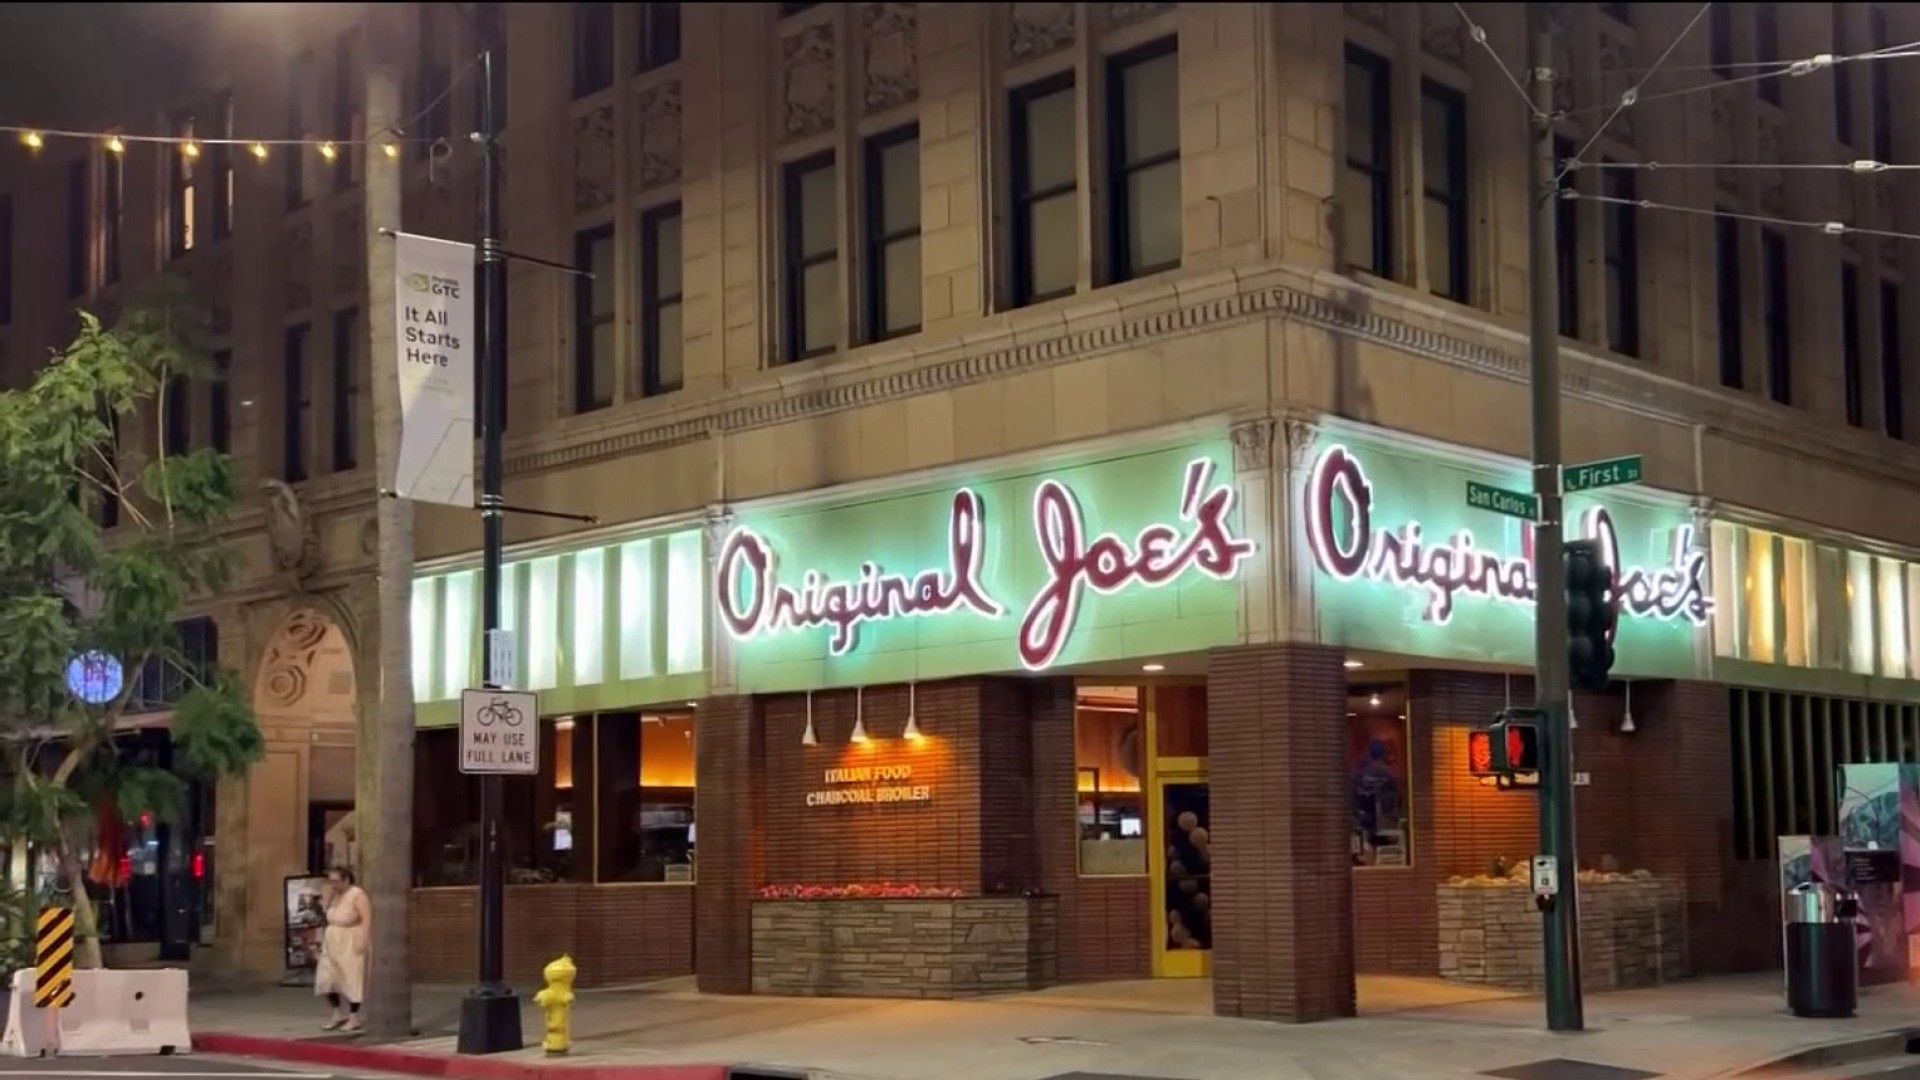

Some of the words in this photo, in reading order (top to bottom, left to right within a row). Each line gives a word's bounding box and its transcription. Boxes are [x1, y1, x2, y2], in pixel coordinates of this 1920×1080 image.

[431, 283, 460, 299] GTC
[405, 306, 419, 322] It
[425, 308, 448, 326] All
[405, 326, 460, 349] Starts
[407, 347, 448, 367] Here
[1578, 464, 1621, 487] First
[1469, 485, 1490, 506] San
[1491, 491, 1526, 515] Carlos
[717, 488, 1004, 656] Original
[1018, 458, 1254, 671] Joe's
[473, 732, 497, 745] MAY
[503, 732, 525, 746] USE
[468, 749, 494, 763] FULL
[502, 751, 531, 764] LANE
[825, 767, 871, 783] ITALIAN
[873, 765, 911, 780] FOOD
[806, 789, 873, 806] CHARCOAL
[876, 786, 929, 802] BROILER
